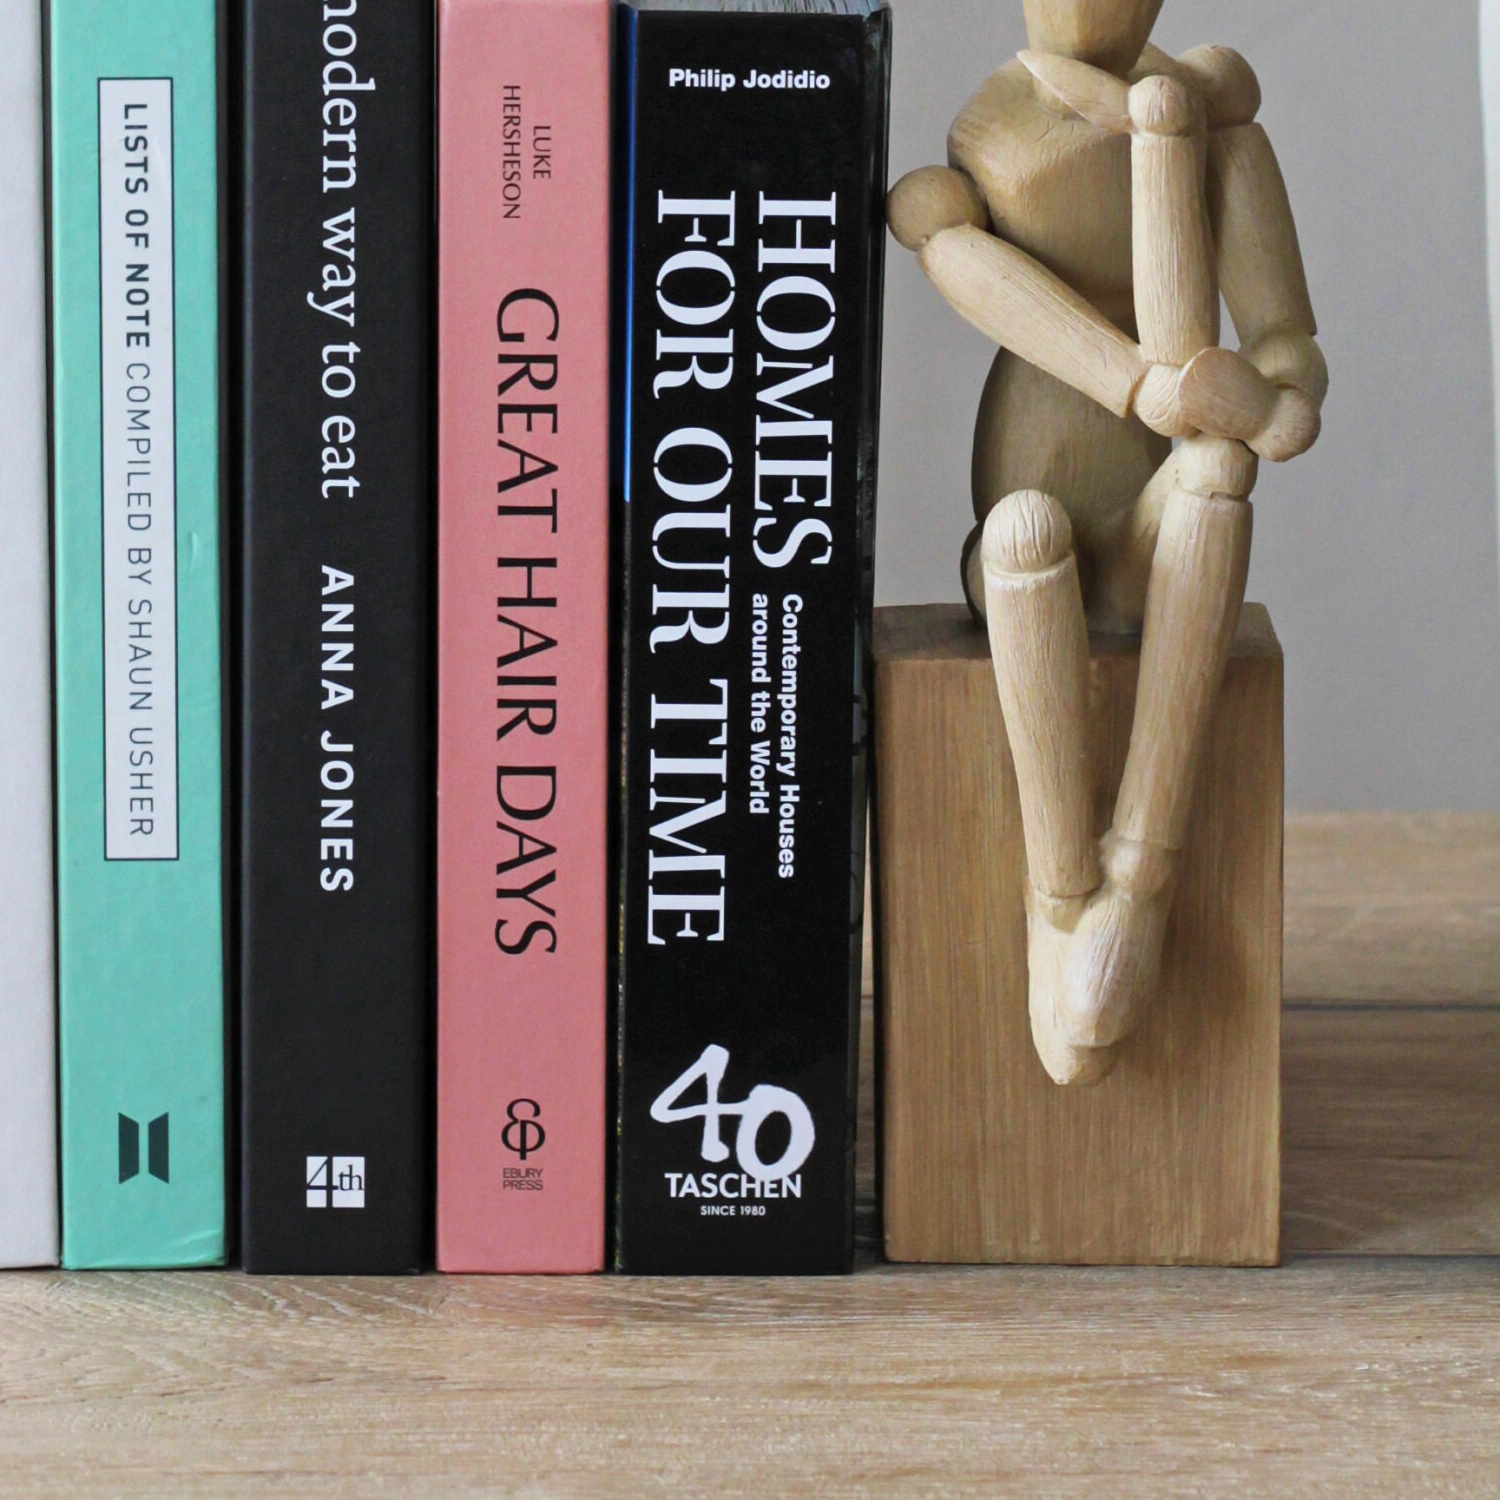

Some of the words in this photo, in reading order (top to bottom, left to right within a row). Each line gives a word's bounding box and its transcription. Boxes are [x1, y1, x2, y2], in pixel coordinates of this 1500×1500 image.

[669, 68, 736, 92] Philip
[742, 69, 831, 89] Jodidio
[124, 103, 149, 194] LISTS
[502, 85, 521, 219] HERSHESON
[532, 125, 551, 179] LUKE
[125, 209, 149, 249] OF
[306, 207, 356, 327] way
[125, 263, 150, 348] NOTE
[652, 189, 736, 399] FOR
[321, 341, 361, 398] to
[496, 287, 560, 534] GREAT
[752, 190, 837, 568] HOMES
[126, 362, 152, 531] COMPILED
[321, 415, 361, 499] eat
[127, 547, 152, 585] BY
[649, 427, 733, 654] OUR
[128, 599, 153, 710] SHAUN
[321, 564, 355, 710] ANNA
[496, 557, 558, 741] HAIR
[751, 593, 772, 683] around
[750, 690, 772, 733] the
[776, 594, 804, 777] Contemporary
[129, 727, 154, 835] USHER
[319, 730, 355, 891] JONES
[647, 678, 729, 946] TIME
[749, 740, 771, 814] World
[494, 765, 557, 955] DAYS
[777, 783, 800, 878] Houses
[649, 1043, 816, 1180] 40
[306, 1155, 366, 1208] 4th
[502, 1167, 544, 1179] EBURY
[502, 1179, 544, 1191] PRESS
[664, 1172, 802, 1199] TASCHEN
[700, 1205, 736, 1216] SINCE
[740, 1205, 766, 1216] 1980
